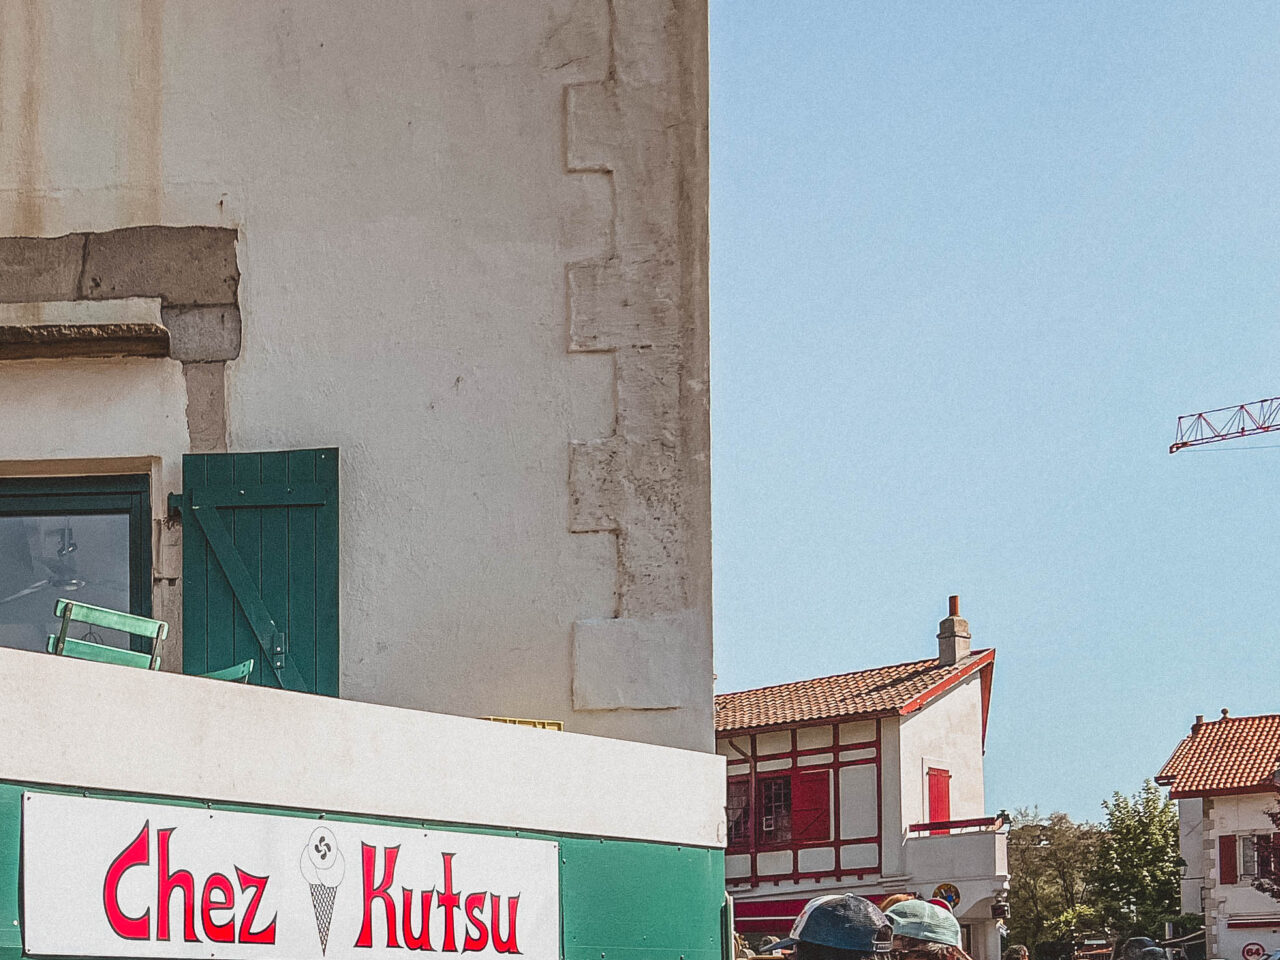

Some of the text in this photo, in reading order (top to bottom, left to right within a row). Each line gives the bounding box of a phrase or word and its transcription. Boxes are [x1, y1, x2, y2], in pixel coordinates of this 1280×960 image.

[102, 819, 524, 956] Chez Kutsu
[1245, 947, 1261, 957] 64
